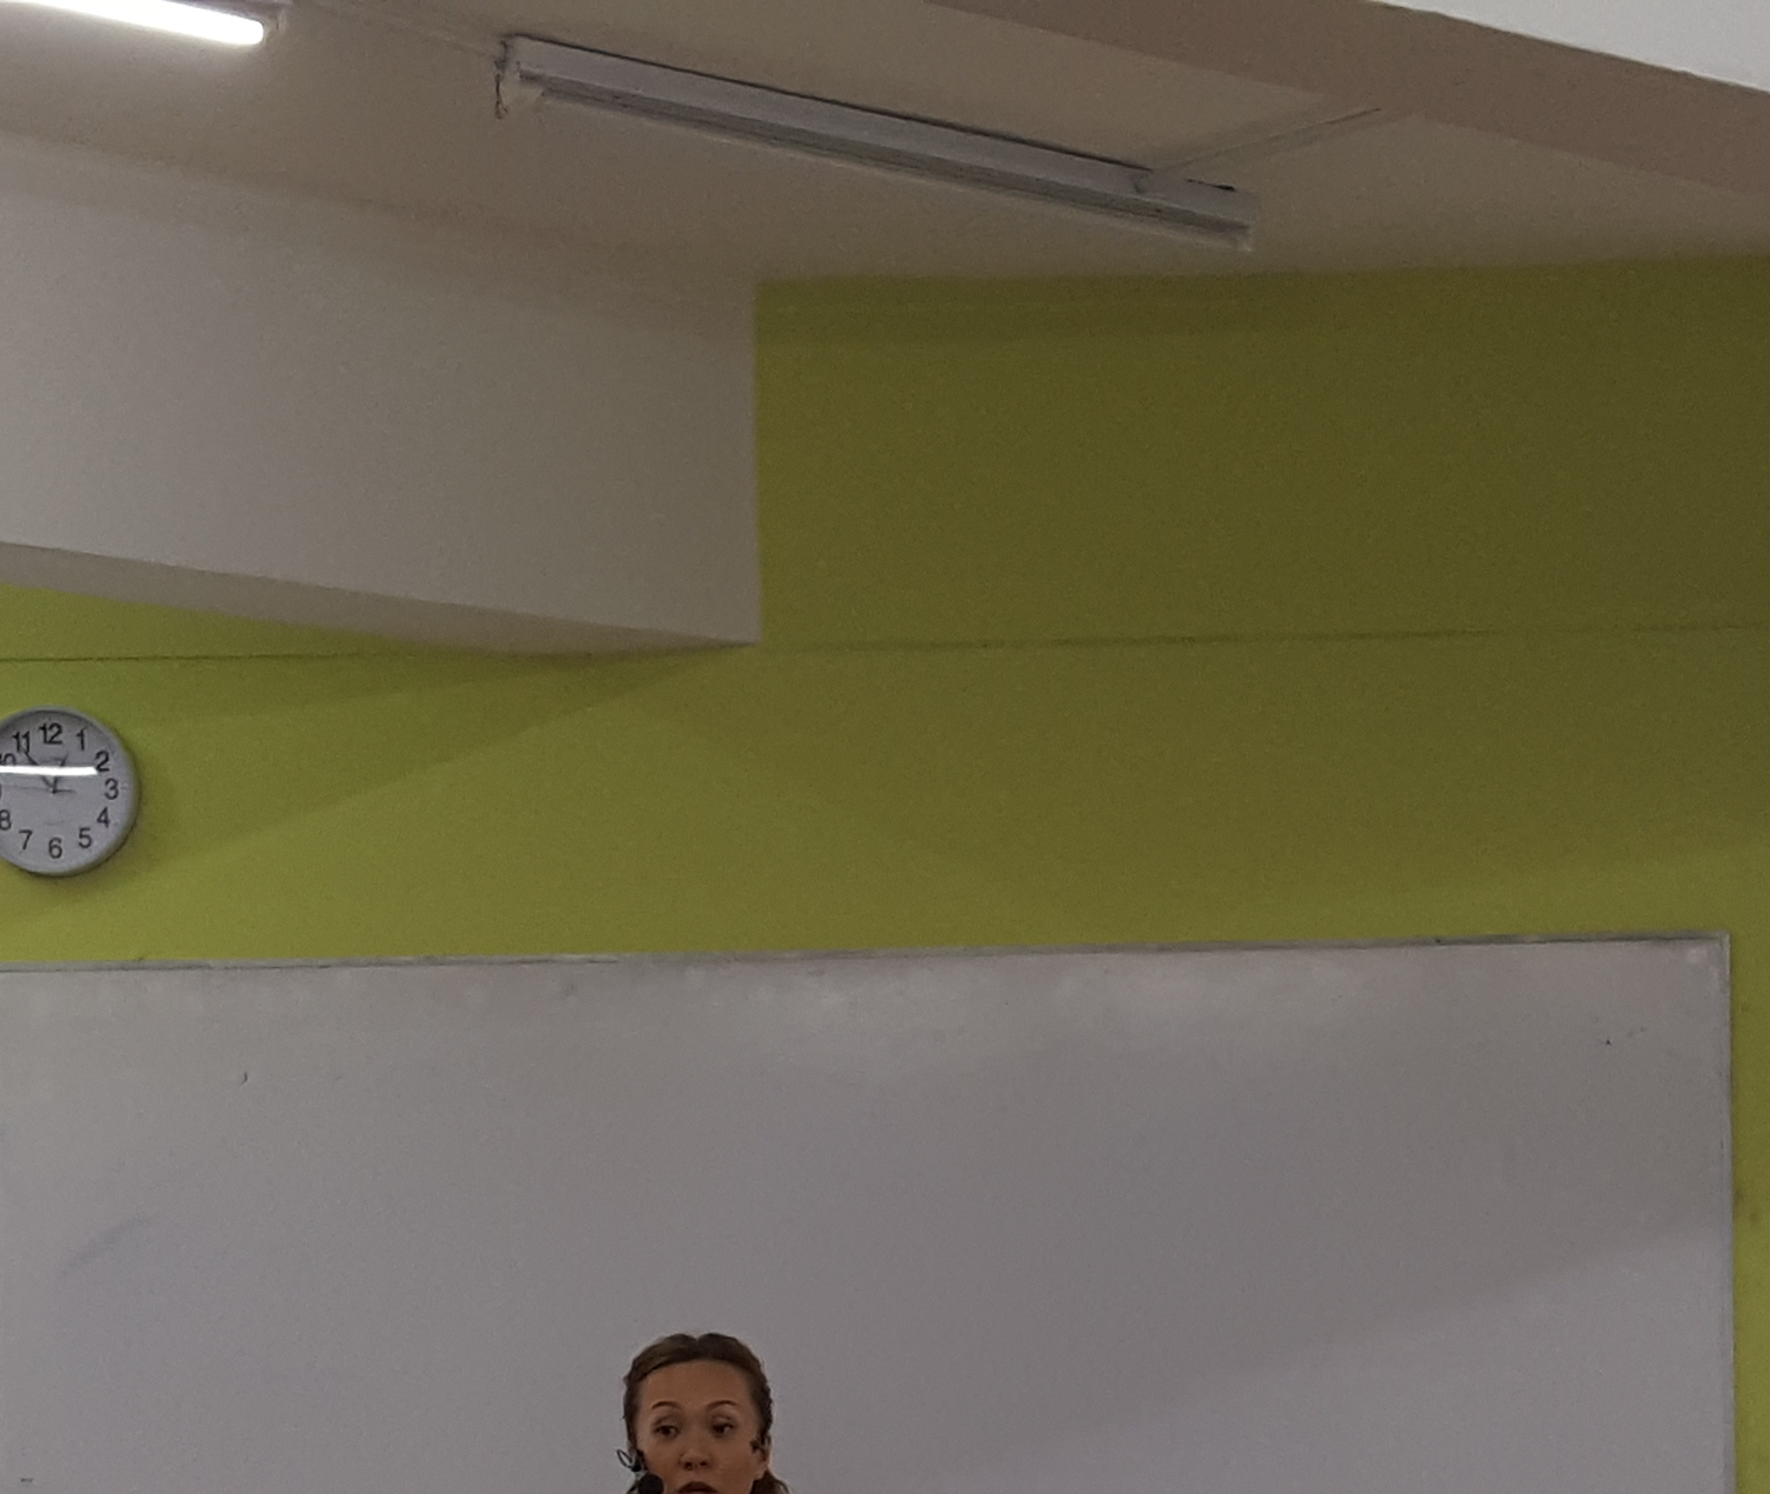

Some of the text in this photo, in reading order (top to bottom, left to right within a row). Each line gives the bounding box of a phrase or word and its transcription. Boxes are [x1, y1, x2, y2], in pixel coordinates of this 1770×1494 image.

[12, 731, 31, 752] 11
[39, 722, 63, 745] 12
[76, 729, 86, 750] 1
[95, 750, 110, 772] 2
[104, 778, 119, 800] 3
[96, 806, 110, 828] 4
[18, 829, 33, 850] 7
[48, 837, 63, 859] 6
[78, 827, 92, 849] 5
